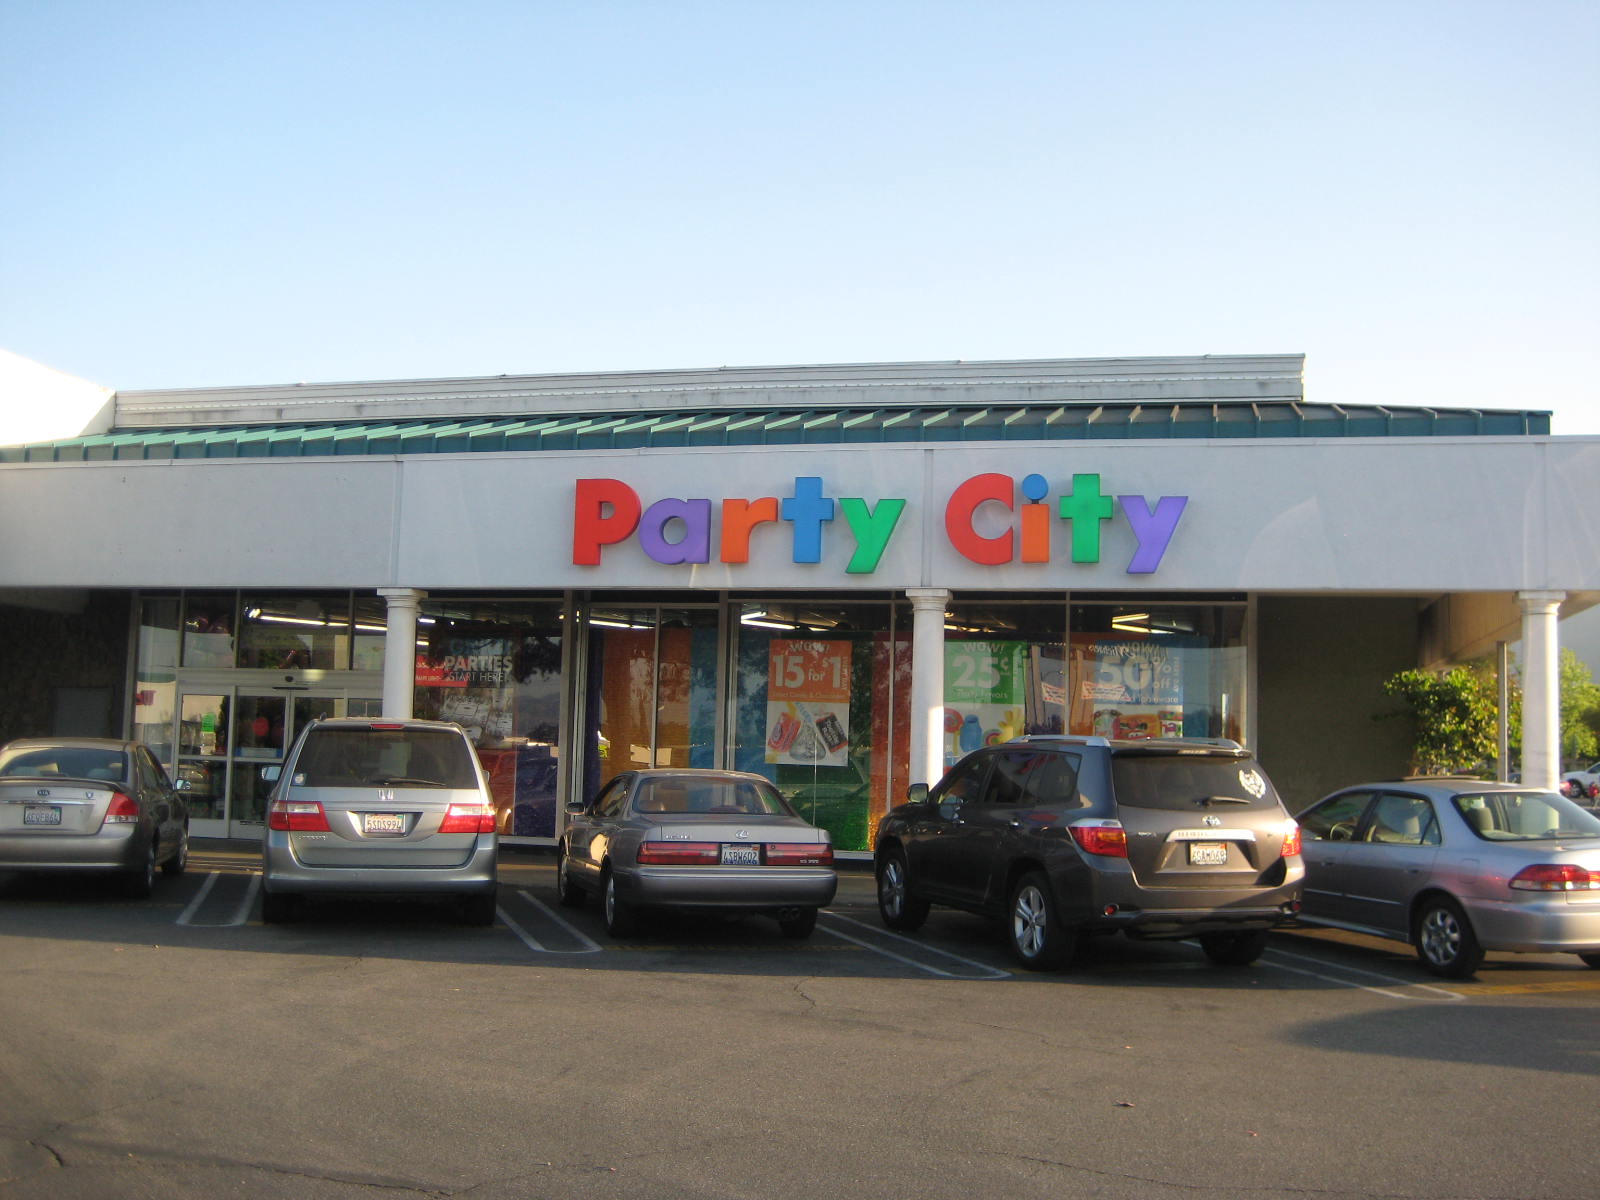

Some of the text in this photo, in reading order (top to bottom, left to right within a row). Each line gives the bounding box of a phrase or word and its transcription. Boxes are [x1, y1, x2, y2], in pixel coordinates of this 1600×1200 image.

[573, 473, 1189, 574] Party City
[444, 655, 513, 671] PARTIES
[450, 672, 476, 681] START
[772, 655, 842, 688] 15 for $1
[1153, 678, 1171, 688] off
